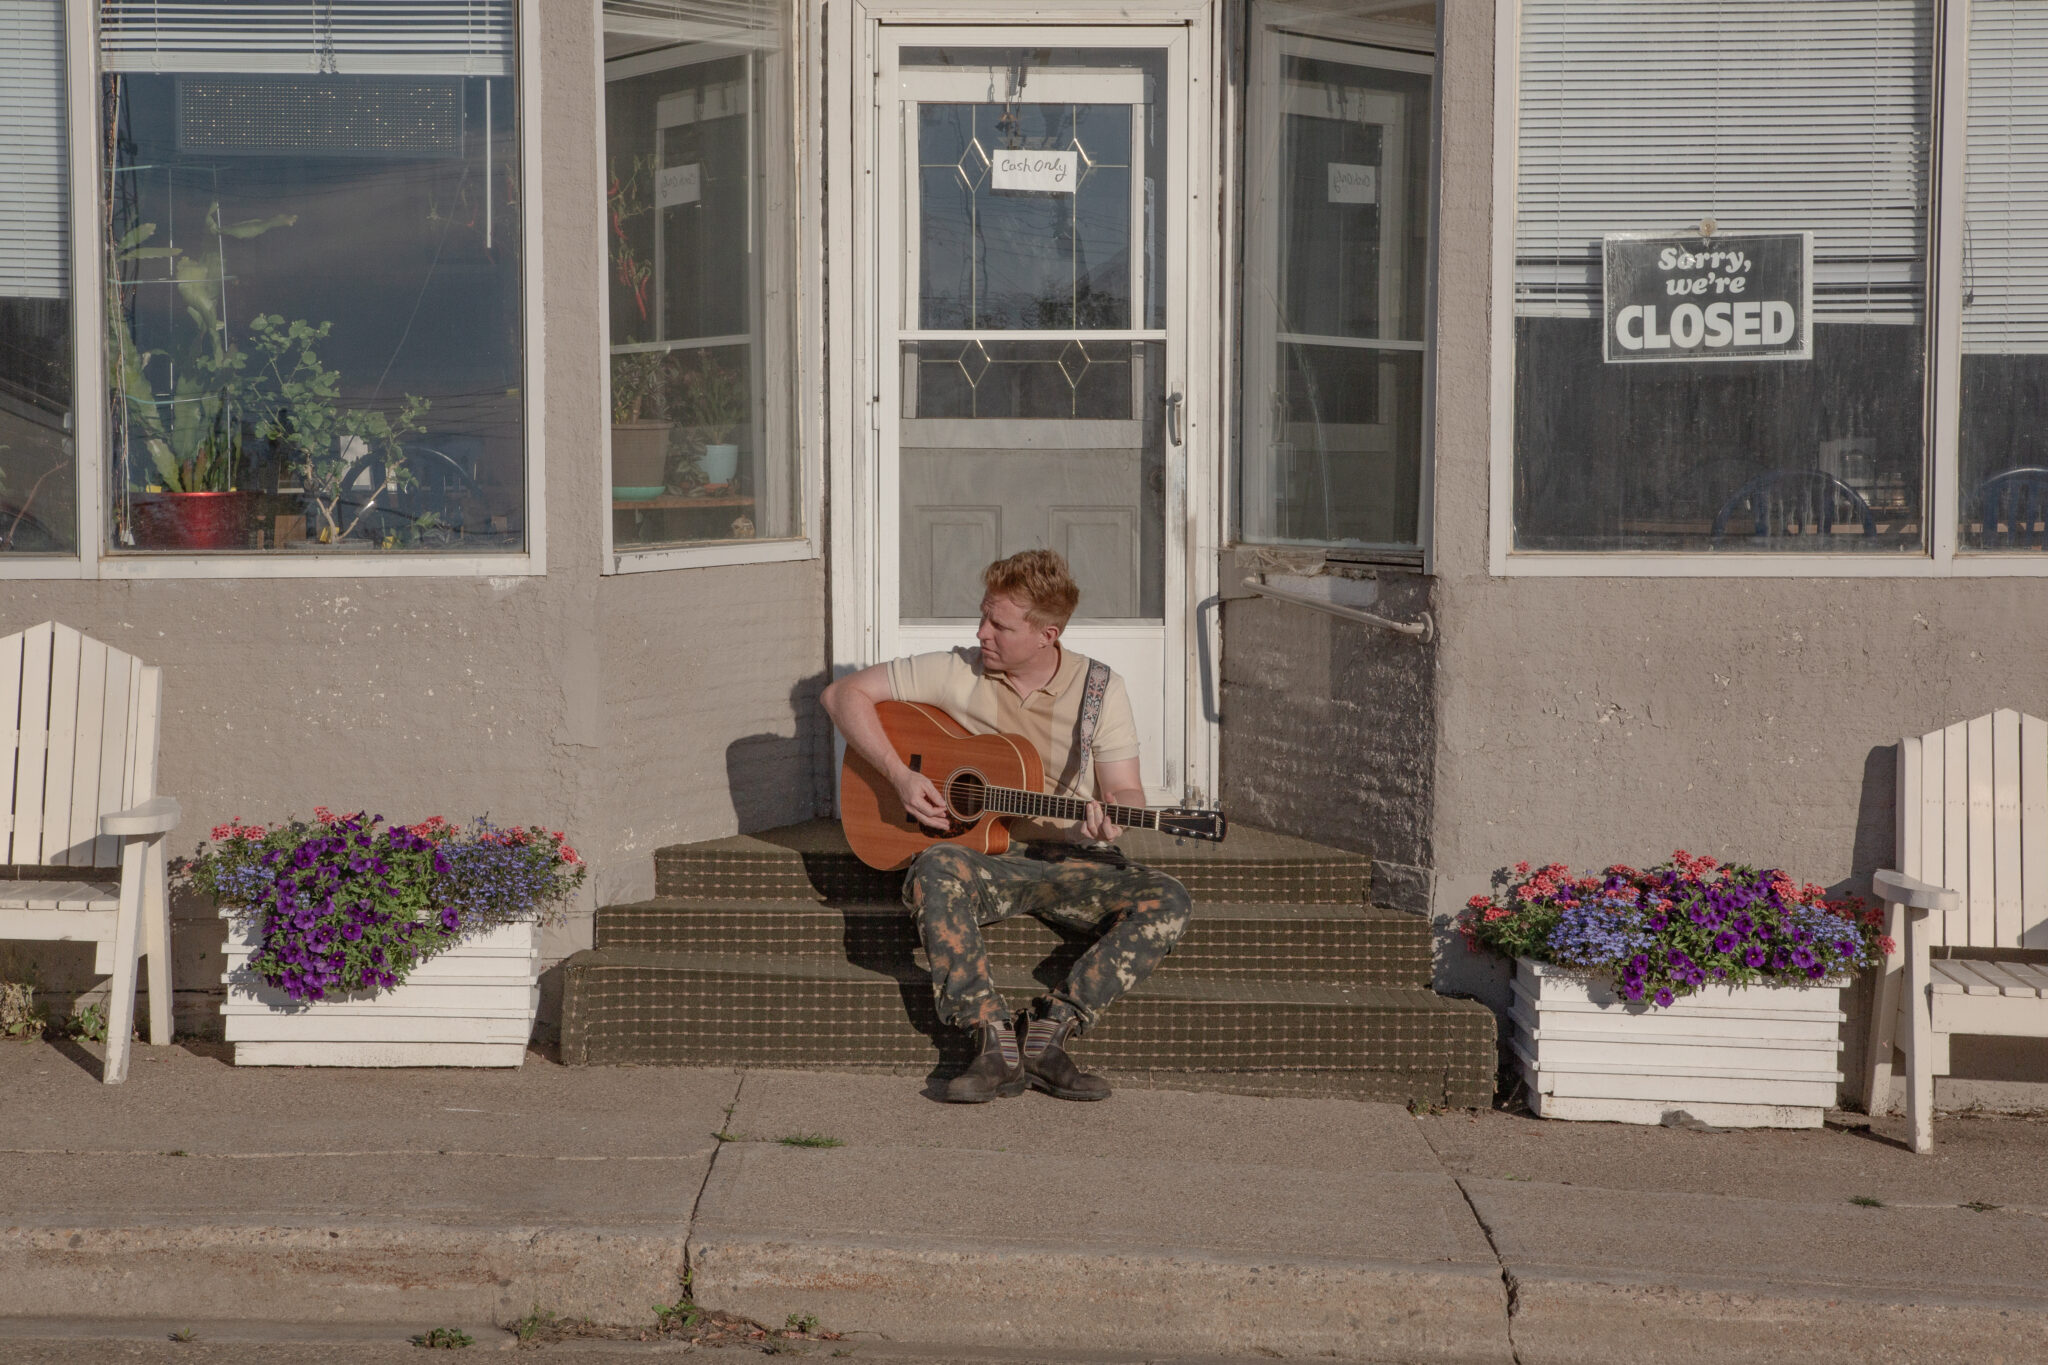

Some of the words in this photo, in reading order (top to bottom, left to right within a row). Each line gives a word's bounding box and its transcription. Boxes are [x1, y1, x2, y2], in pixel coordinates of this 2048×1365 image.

[1001, 158, 1031, 172] Cash
[1033, 158, 1067, 182] Only
[1658, 247, 1752, 273] Sorry,
[1666, 272, 1746, 295] we're
[1615, 300, 1795, 350] CLOSED
